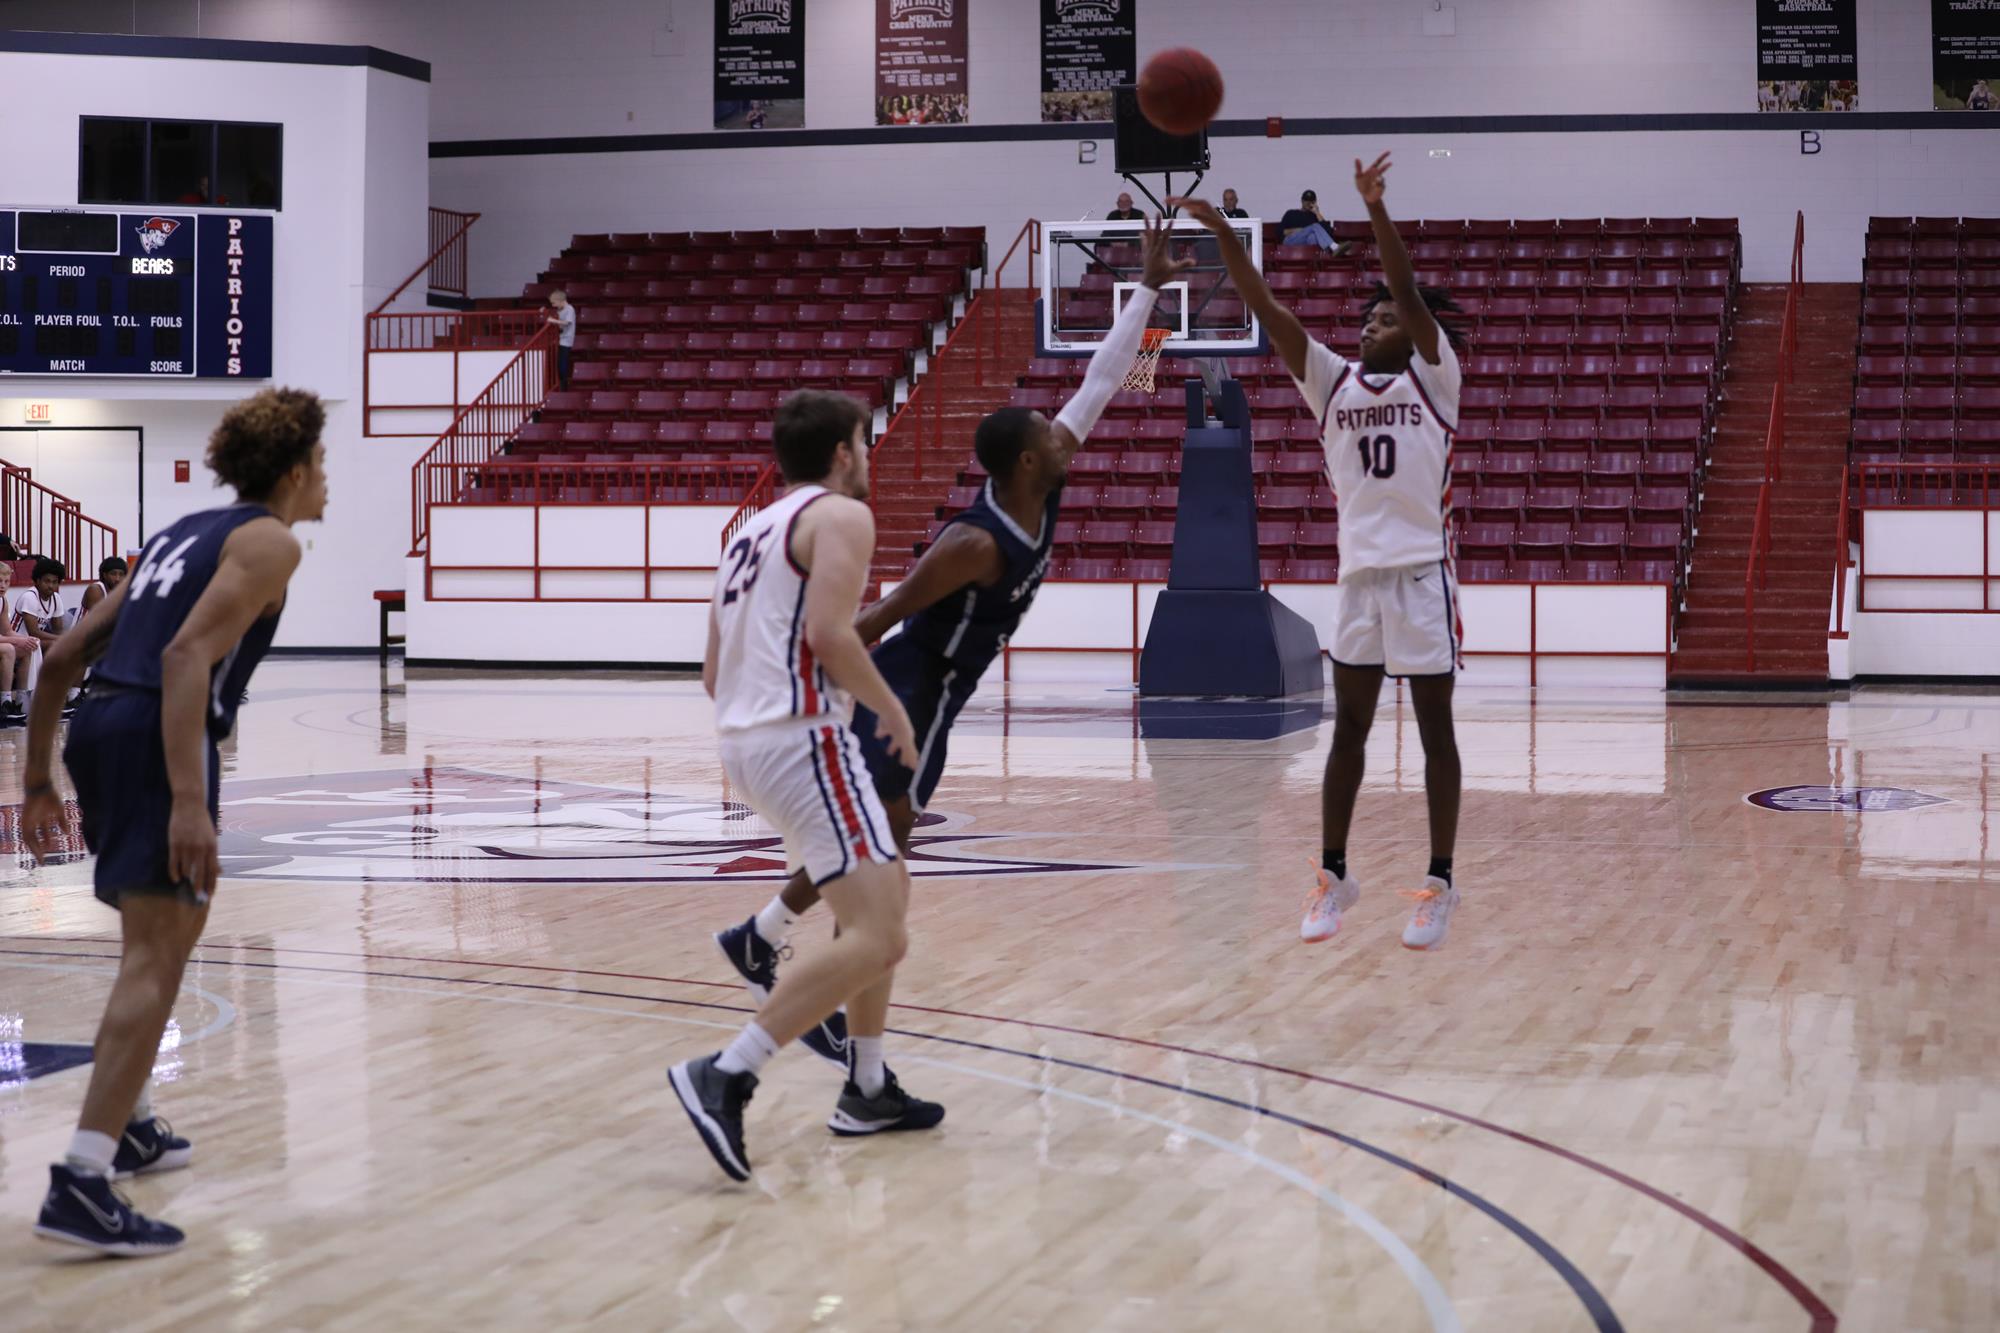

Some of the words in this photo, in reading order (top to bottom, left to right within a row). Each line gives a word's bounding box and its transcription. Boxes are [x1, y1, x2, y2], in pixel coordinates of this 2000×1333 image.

[731, 0, 790, 20] PATRIOTS
[1949, 2, 1978, 10] TRACK
[916, 20, 953, 28] COUNTRY
[1061, 14, 1114, 23] BASKETBALL
[755, 26, 791, 34] COUNTRY
[1801, 130, 1822, 154] B
[1078, 140, 1097, 164] B
[49, 265, 86, 277] PERIOD
[131, 257, 174, 275] BEARS
[226, 218, 244, 375] PATRIOTS
[34, 314, 73, 326] PLAYER
[76, 315, 102, 327] FOUL
[112, 315, 140, 327] T.O.L.
[150, 316, 183, 328] FOULS
[50, 360, 85, 371] MATCH
[150, 361, 183, 372] SCORE
[31, 404, 49, 419] EXIT
[1358, 434, 1396, 479] 10
[128, 534, 199, 601] 44
[721, 524, 774, 606] 25
